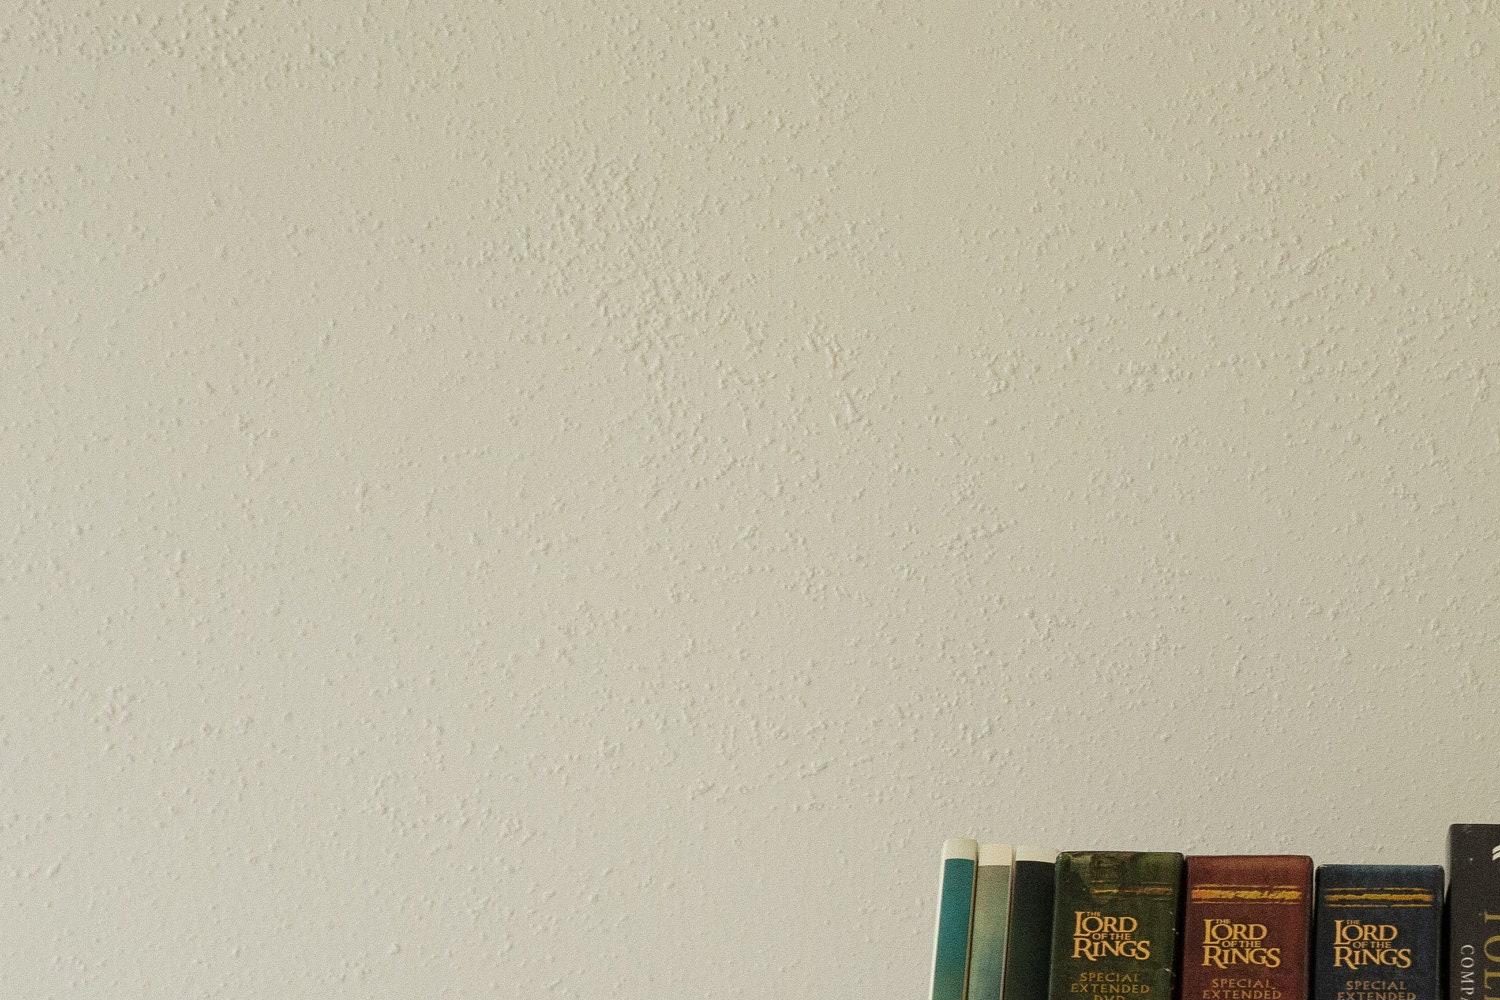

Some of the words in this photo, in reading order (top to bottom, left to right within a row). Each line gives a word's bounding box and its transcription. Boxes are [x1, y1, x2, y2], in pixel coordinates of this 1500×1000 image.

[1073, 911, 1138, 936] LORD
[1203, 919, 1268, 944] LORD
[1333, 920, 1398, 945] LORD
[1071, 937, 1151, 962] RINGS
[1221, 940, 1238, 948] OF
[1352, 941, 1368, 949] OF
[1370, 941, 1392, 949] THE
[1201, 945, 1281, 969] RINGS
[1332, 946, 1412, 970] RINGS
[1080, 972, 1138, 982] SPECIAL
[1070, 983, 1150, 994] EXTENDED
[1212, 979, 1272, 988] SPECIAL
[1346, 980, 1407, 990] SPECIAL
[1202, 990, 1282, 999] EXTENDED
